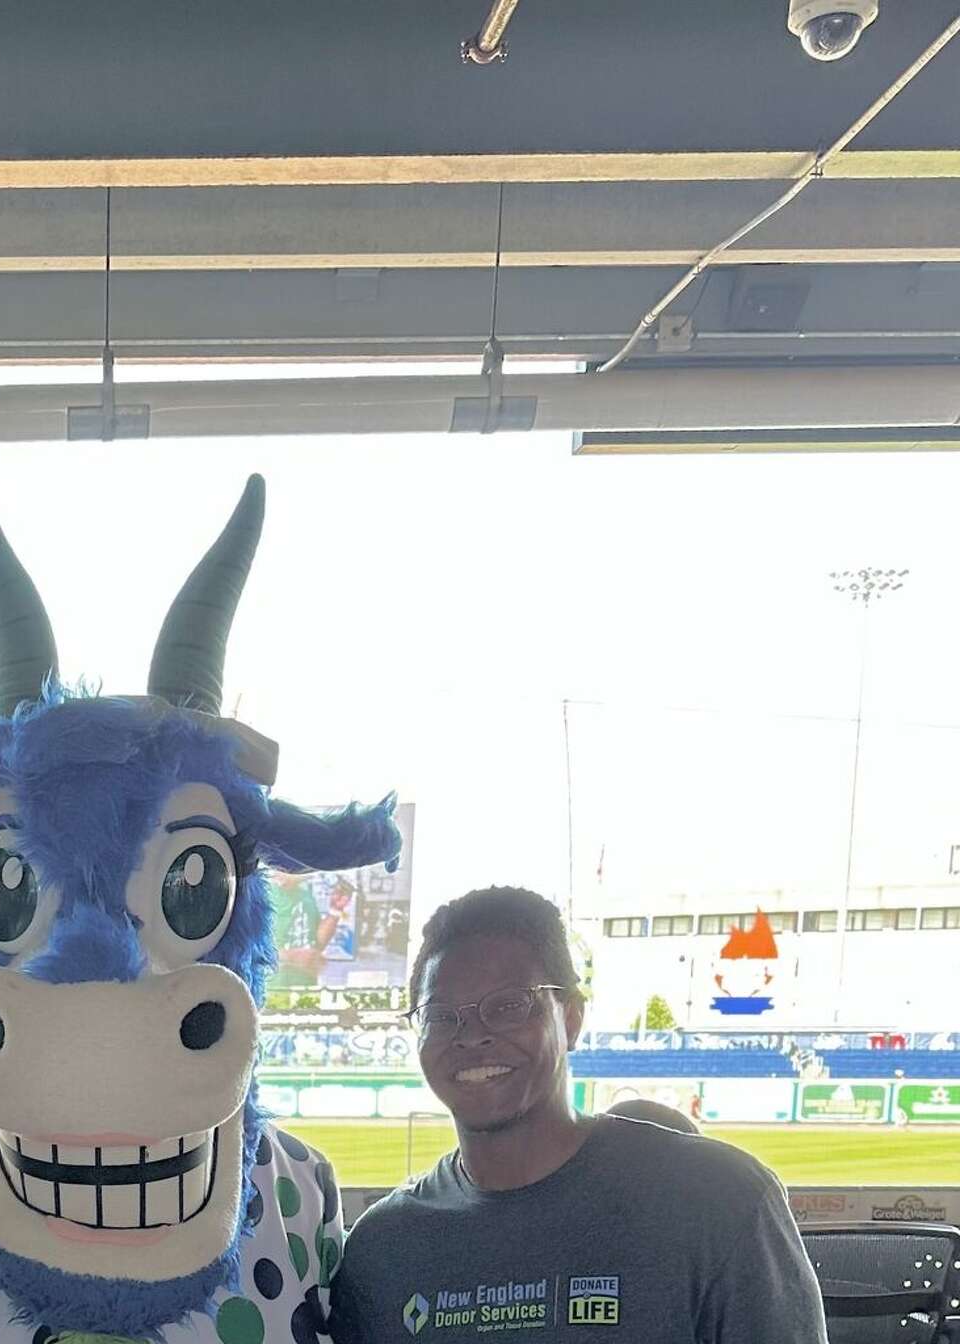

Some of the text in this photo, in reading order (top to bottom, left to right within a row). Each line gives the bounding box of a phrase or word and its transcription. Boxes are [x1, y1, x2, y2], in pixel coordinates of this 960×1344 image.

[436, 1279, 547, 1310] New England
[572, 1279, 617, 1291] DONATE
[435, 1302, 547, 1328] Donor Services
[572, 1300, 616, 1321] LIFE
